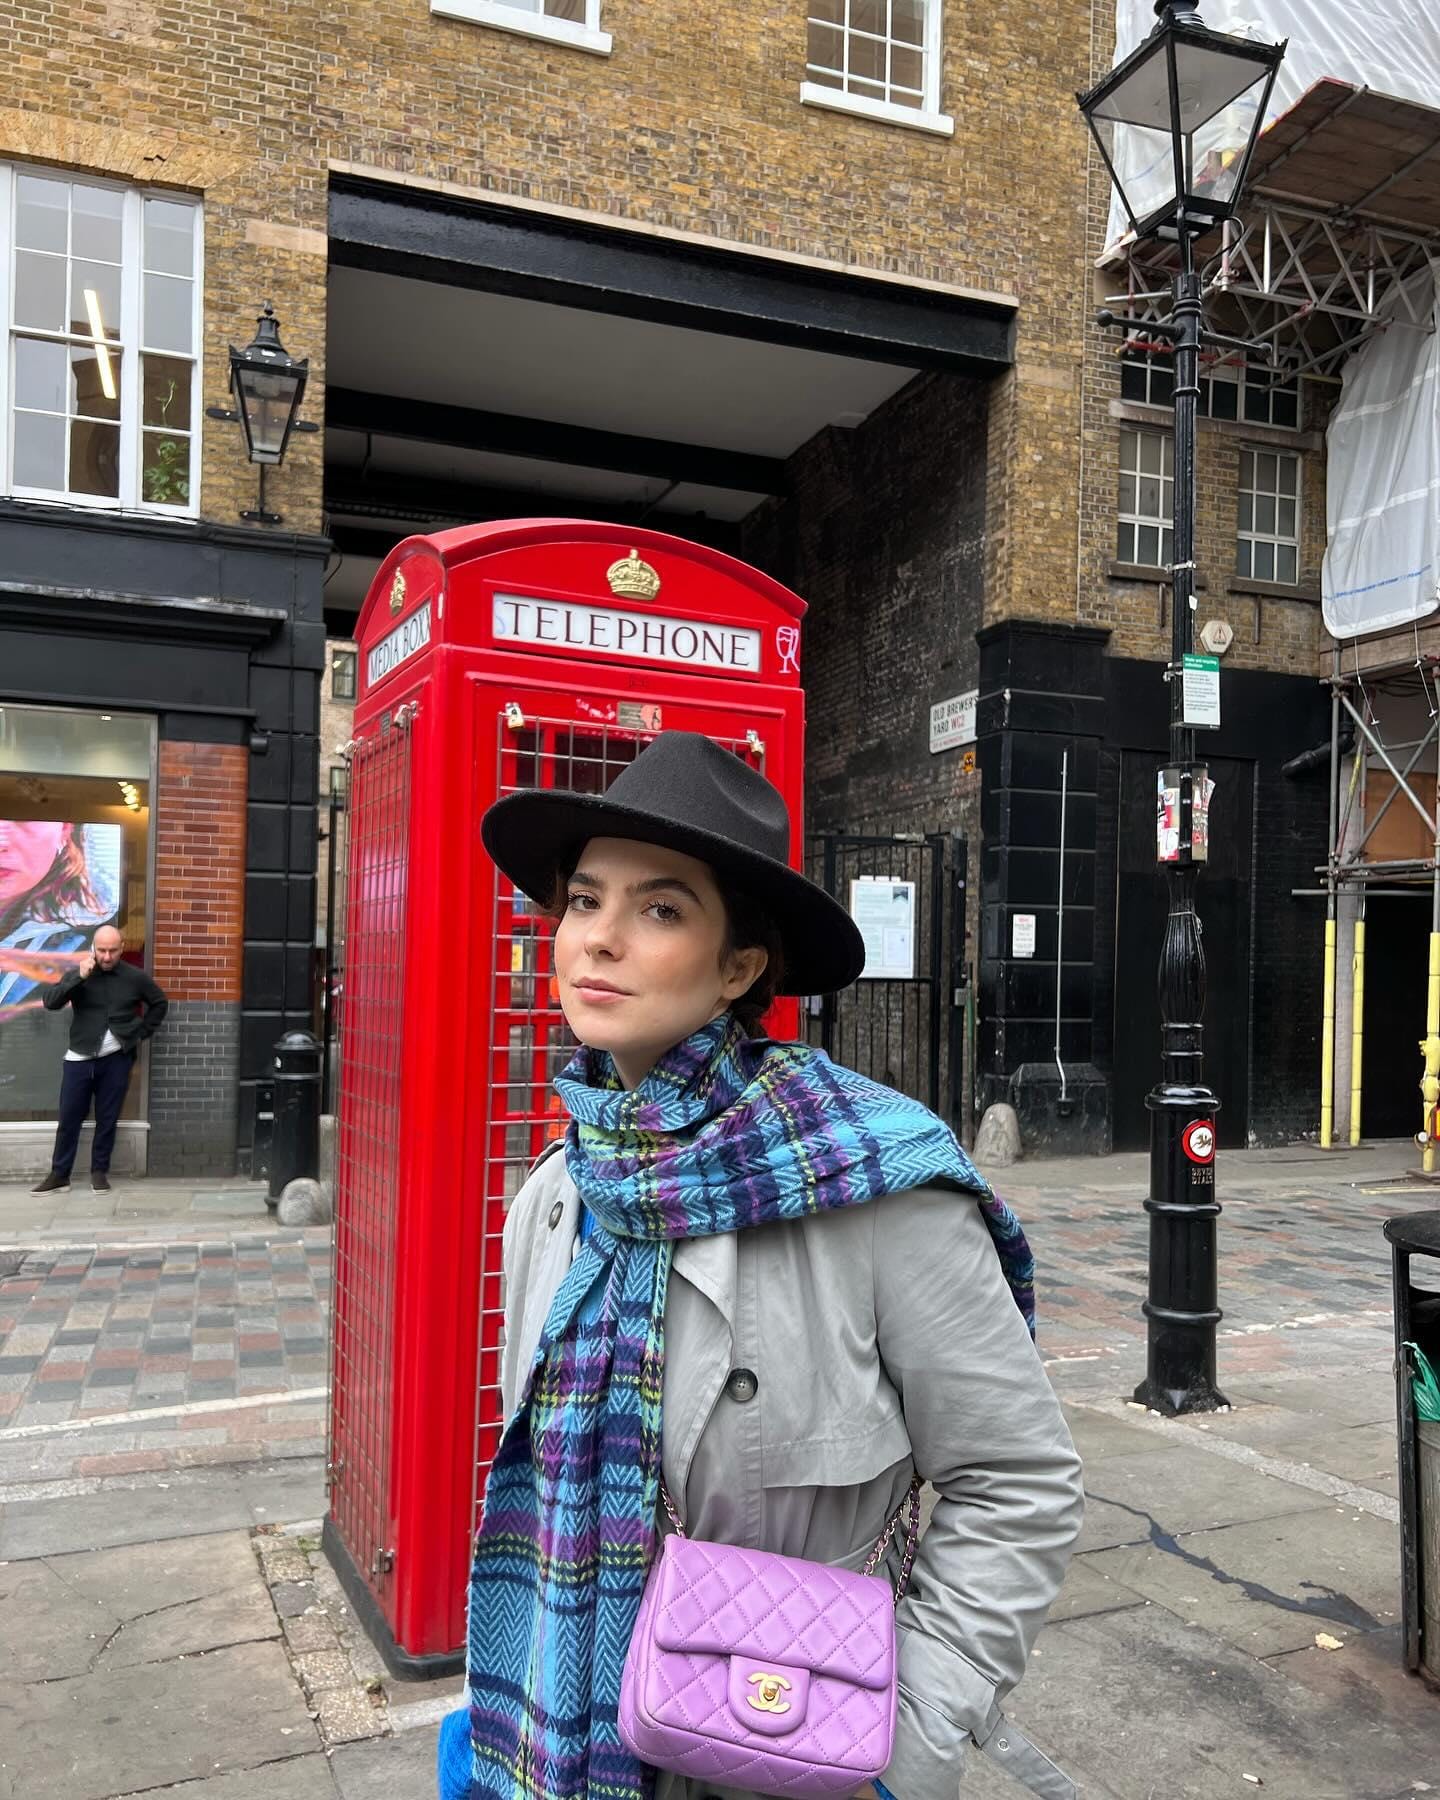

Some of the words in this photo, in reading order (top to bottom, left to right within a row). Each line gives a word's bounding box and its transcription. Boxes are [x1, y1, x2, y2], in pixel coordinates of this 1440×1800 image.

[503, 601, 751, 666] TELEPHONE
[370, 634, 400, 681] MEDIA
[932, 706, 945, 722] OLD
[946, 696, 978, 717] BREWER
[933, 719, 949, 736] YARD
[950, 713, 965, 730] WC2
